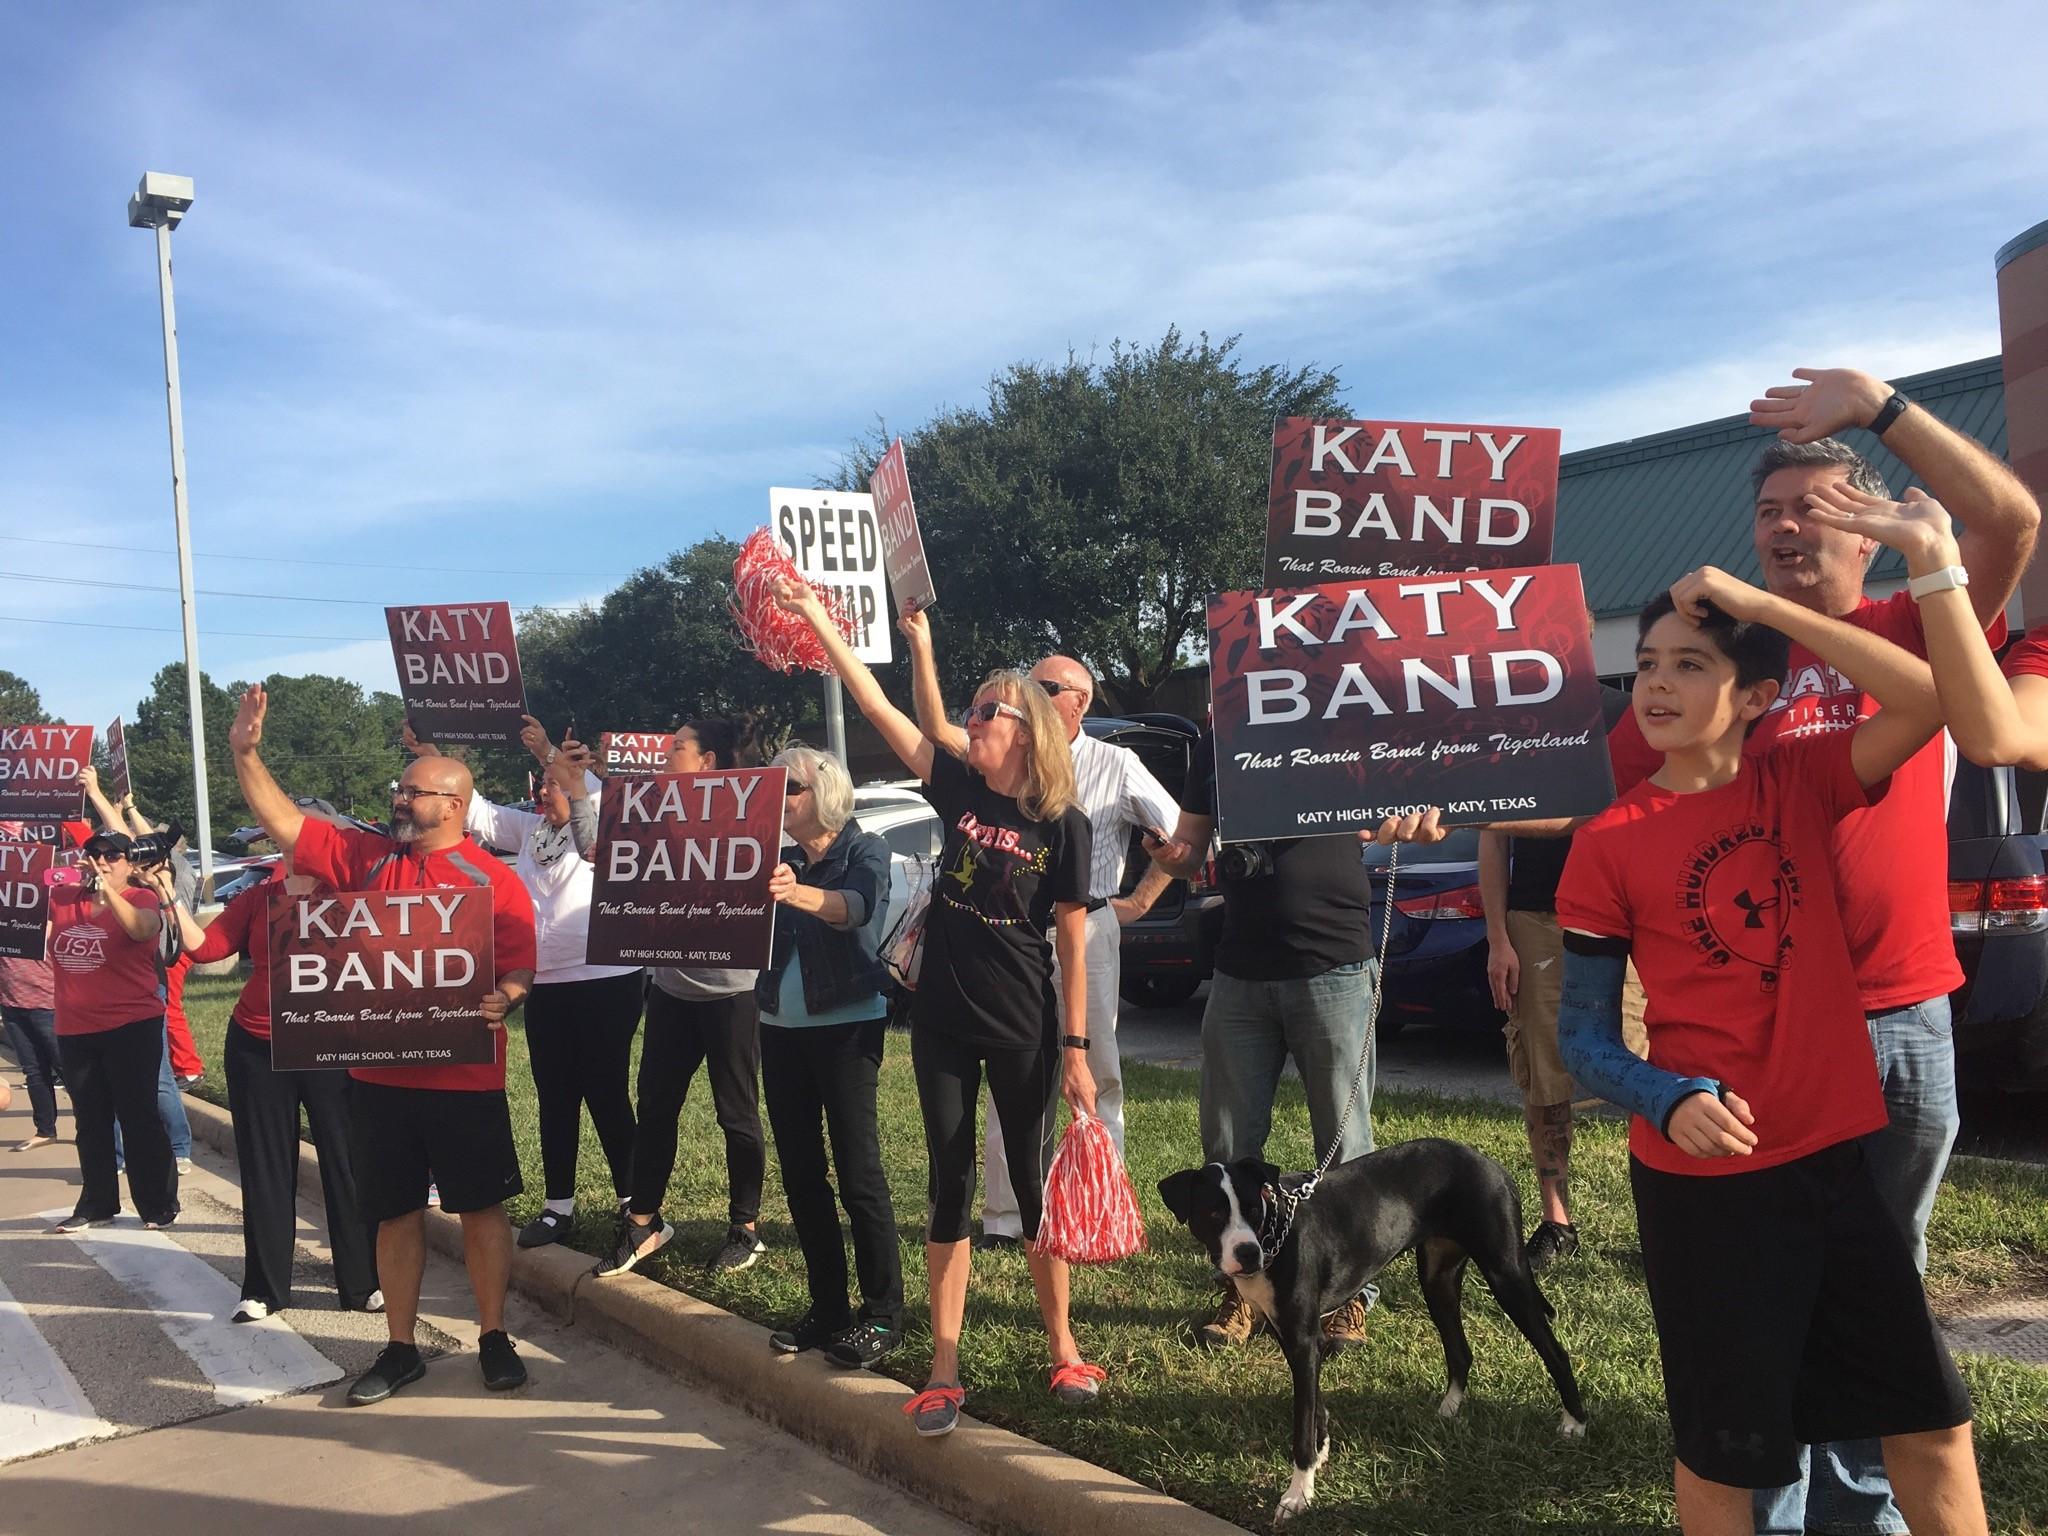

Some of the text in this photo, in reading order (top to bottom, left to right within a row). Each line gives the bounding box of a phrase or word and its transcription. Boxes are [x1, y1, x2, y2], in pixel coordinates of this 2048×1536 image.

[1310, 425, 1527, 481] KATY
[874, 450, 901, 511] KATY
[881, 500, 913, 557] BAND
[1292, 490, 1530, 546] BAND
[779, 505, 877, 572] SPEED
[1279, 557, 1314, 573] That
[1319, 559, 1371, 576] Roarin
[1379, 562, 1417, 577] Band
[400, 608, 494, 642] KATY
[1256, 575, 1535, 649] KATY
[404, 652, 510, 684] BAND
[1244, 649, 1564, 726] BAND
[408, 698, 424, 709] That
[449, 698, 467, 709] Band
[470, 699, 485, 711] from
[487, 698, 520, 711] Tigerland
[1788, 704, 1855, 722] TIGER
[1, 728, 80, 750] KATY
[611, 734, 666, 748] KATY
[1234, 729, 1589, 771] That Roarin Band from Tigerland
[0, 757, 79, 780] BAND
[620, 775, 762, 823] KATY
[1297, 811, 1334, 824] KATY
[1336, 808, 1372, 822] HIGH
[1448, 800, 1487, 813] KATY,
[1490, 796, 1537, 811] TEXAS
[608, 837, 763, 882] BAND
[297, 894, 466, 939] KATY
[598, 902, 766, 919] That Roarin Band from Tigerland
[54, 935, 106, 961] USA
[620, 949, 637, 958] KATY
[638, 950, 655, 959] HIGH
[656, 951, 683, 960] SCHOOL
[689, 952, 707, 961] KATY,
[709, 952, 731, 961] TEXAS
[288, 948, 476, 993] BAND
[281, 1010, 309, 1024] That
[313, 1009, 355, 1024] Roarin
[360, 1008, 391, 1021] Band
[395, 1008, 423, 1023] from
[316, 1053, 337, 1062] KATY
[338, 1052, 360, 1061] HIGH
[361, 1051, 395, 1060] SCHOOL
[402, 1050, 423, 1060] KATY,
[425, 1049, 451, 1058] TEXAS
